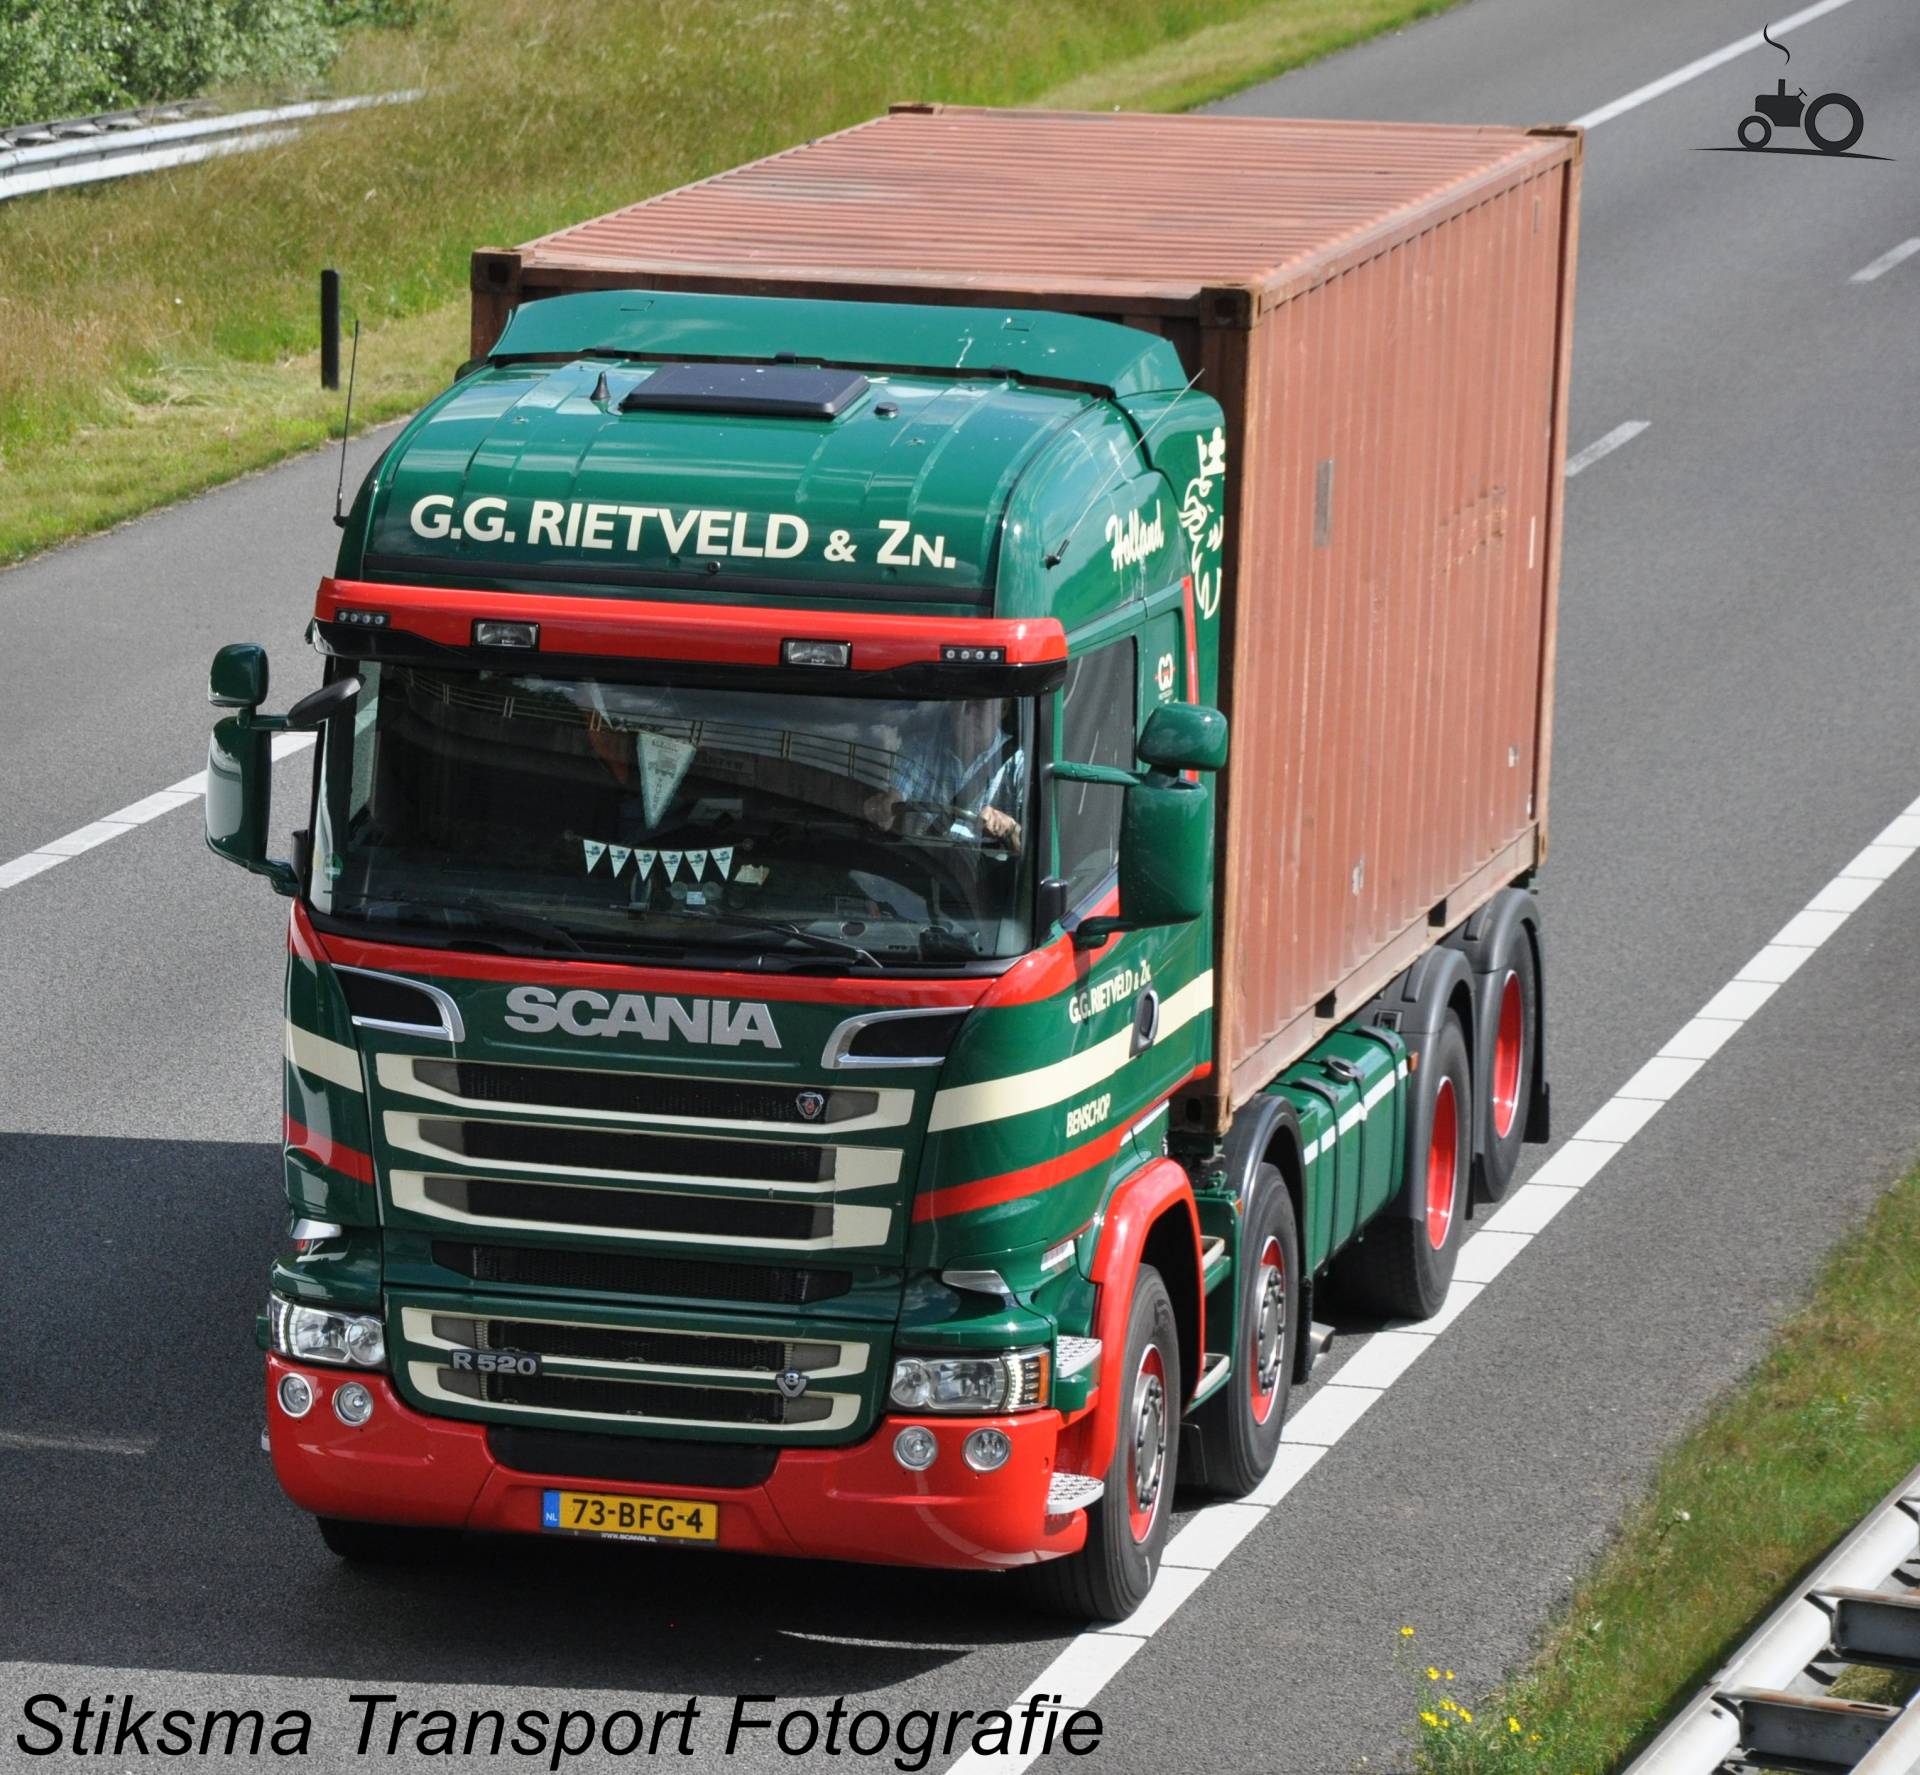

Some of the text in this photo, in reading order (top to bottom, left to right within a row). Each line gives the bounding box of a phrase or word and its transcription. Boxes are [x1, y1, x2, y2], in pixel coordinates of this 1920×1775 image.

[409, 493, 515, 543] G.G.
[526, 500, 810, 560] RIETVELD
[823, 529, 856, 563] &
[1106, 500, 1164, 572] Holland
[504, 986, 783, 1049] SCANIA
[1068, 992, 1091, 1024] G.G.
[1090, 969, 1133, 1015] RIETVELD
[1066, 1093, 1112, 1139] BENSCHOP
[452, 1352, 538, 1376] R 520
[545, 1498, 704, 1534] NL 73-BFG-4
